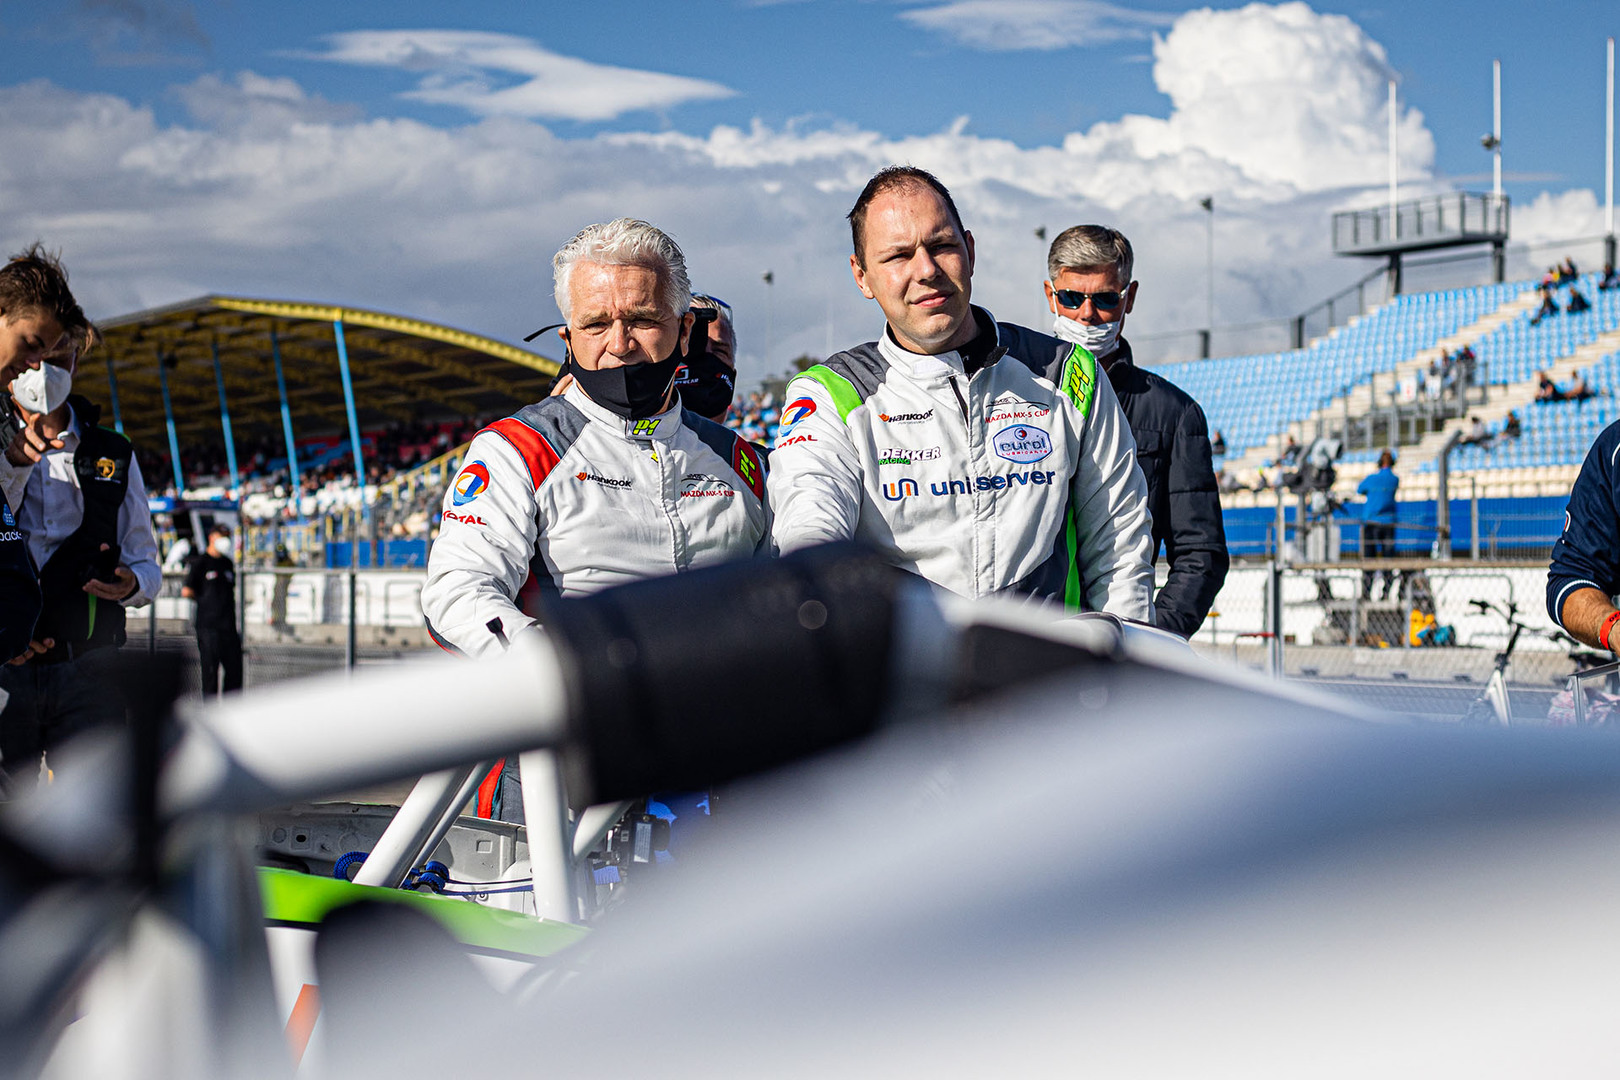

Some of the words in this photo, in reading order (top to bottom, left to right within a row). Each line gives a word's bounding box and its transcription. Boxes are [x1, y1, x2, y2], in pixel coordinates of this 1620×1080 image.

[889, 409, 934, 423] Hankook
[985, 412, 1012, 424] MAZDA
[1034, 408, 1050, 417] CUP
[1001, 437, 1047, 452] eurol
[880, 446, 941, 461] DEKKER
[587, 474, 632, 488] Hankook
[931, 470, 1056, 496] uniserver
[680, 490, 705, 498] MAZDA
[443, 510, 487, 526] TOTAL
